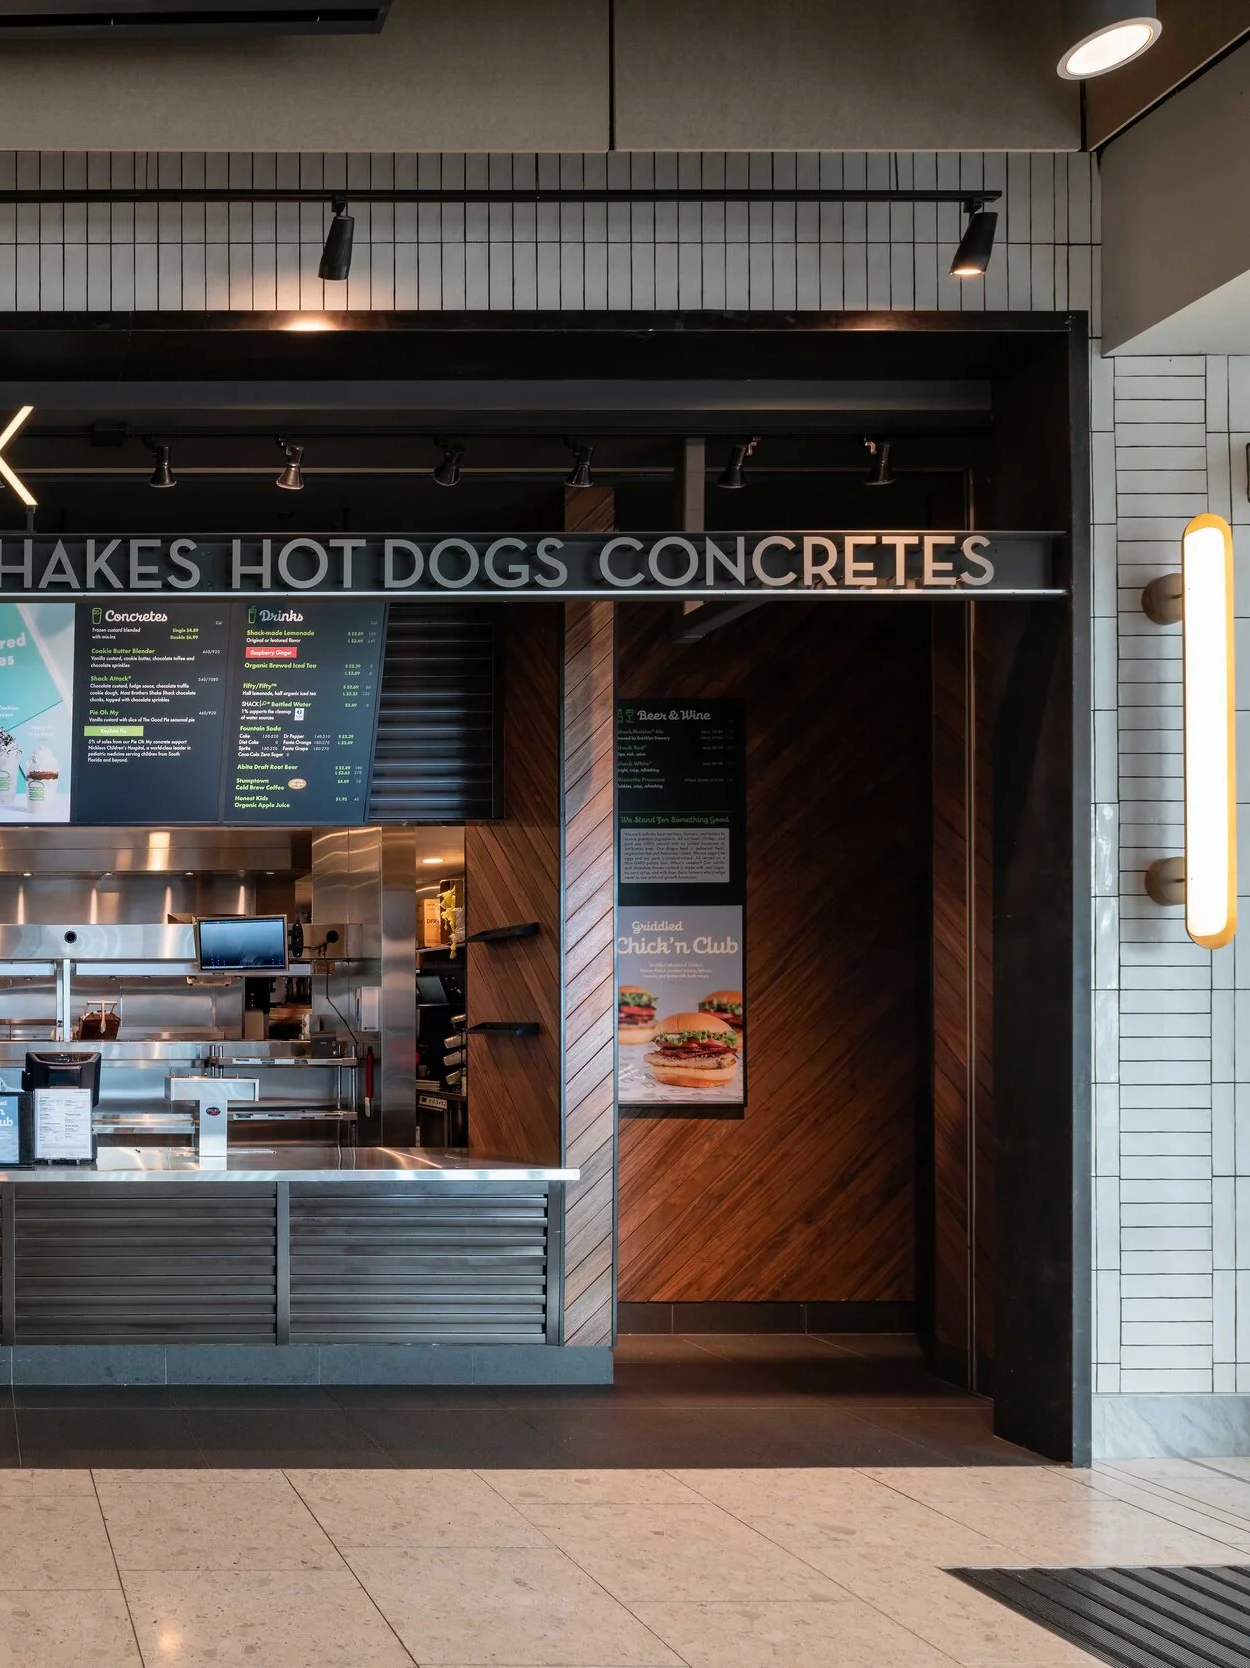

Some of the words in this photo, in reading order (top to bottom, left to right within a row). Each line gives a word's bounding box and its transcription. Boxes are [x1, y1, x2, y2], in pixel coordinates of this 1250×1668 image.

[230, 537, 367, 589] HOT
[383, 537, 569, 589] DOGS
[598, 535, 995, 588] CONCRETES
[105, 610, 168, 622] Concretes
[259, 610, 304, 622] Drinks
[637, 709, 667, 721] Beer
[668, 709, 679, 721] &
[680, 709, 711, 721] Wine
[632, 921, 684, 934] Griddled
[693, 937, 739, 954] Club
